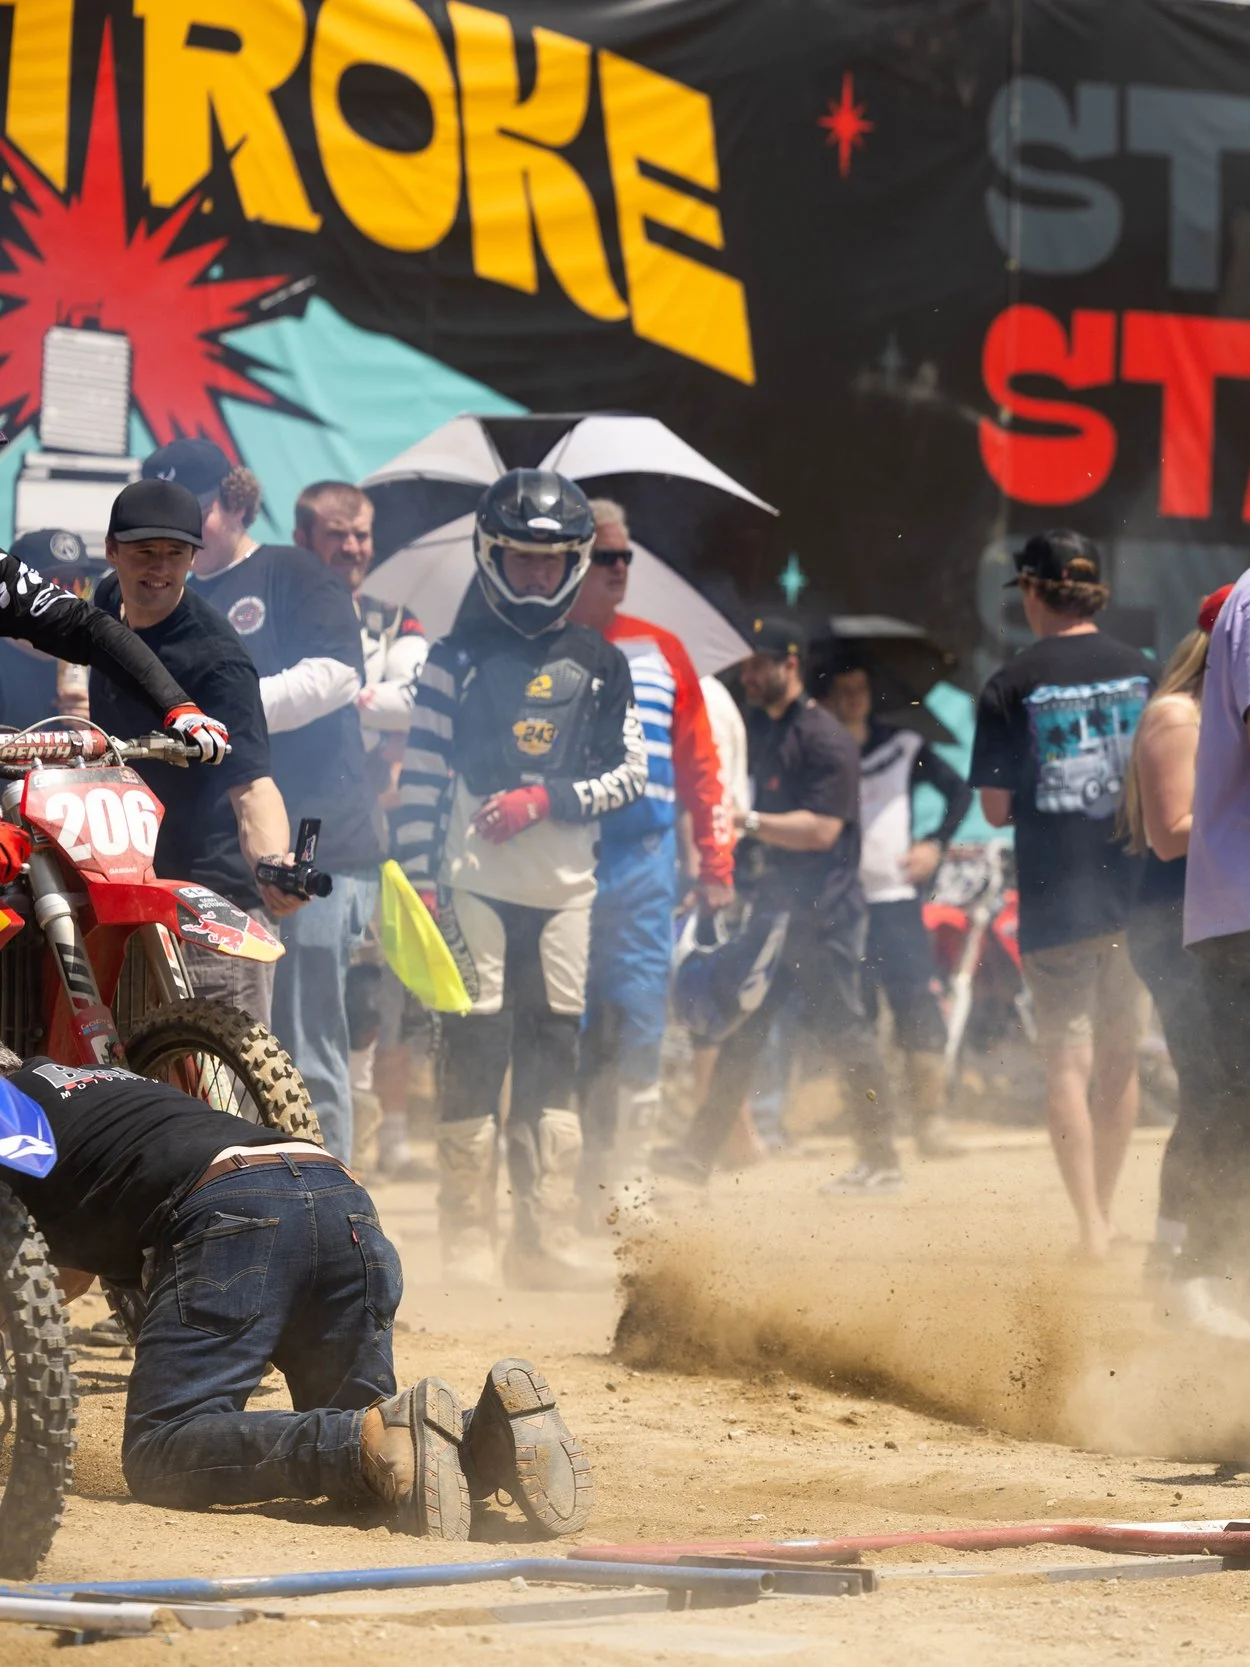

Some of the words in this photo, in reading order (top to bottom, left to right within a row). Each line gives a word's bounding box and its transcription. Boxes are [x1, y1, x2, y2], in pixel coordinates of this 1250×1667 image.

[0, 732, 69, 745] RENTH
[521, 725, 556, 744] 243
[1, 745, 71, 759] RENTH
[45, 788, 159, 862] 206
